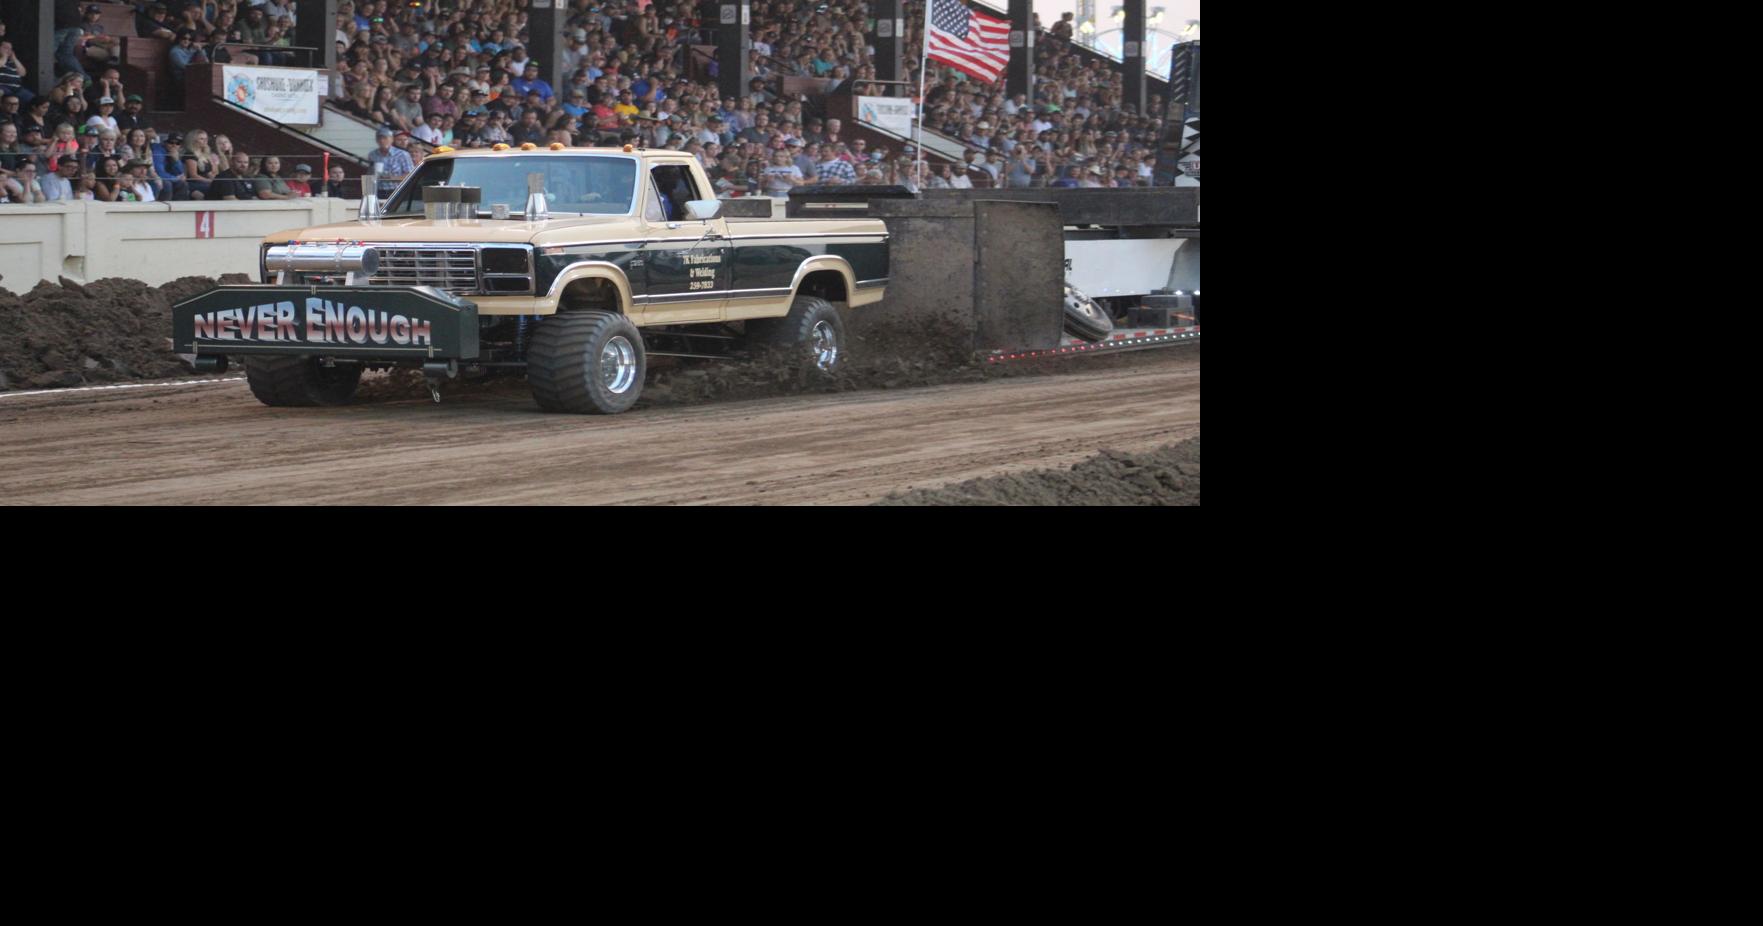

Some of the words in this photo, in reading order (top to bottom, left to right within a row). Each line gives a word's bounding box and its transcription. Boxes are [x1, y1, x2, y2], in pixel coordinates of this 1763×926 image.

[200, 211, 210, 238] 4
[194, 300, 302, 343] NEVER
[305, 297, 431, 345] ENOUGH
